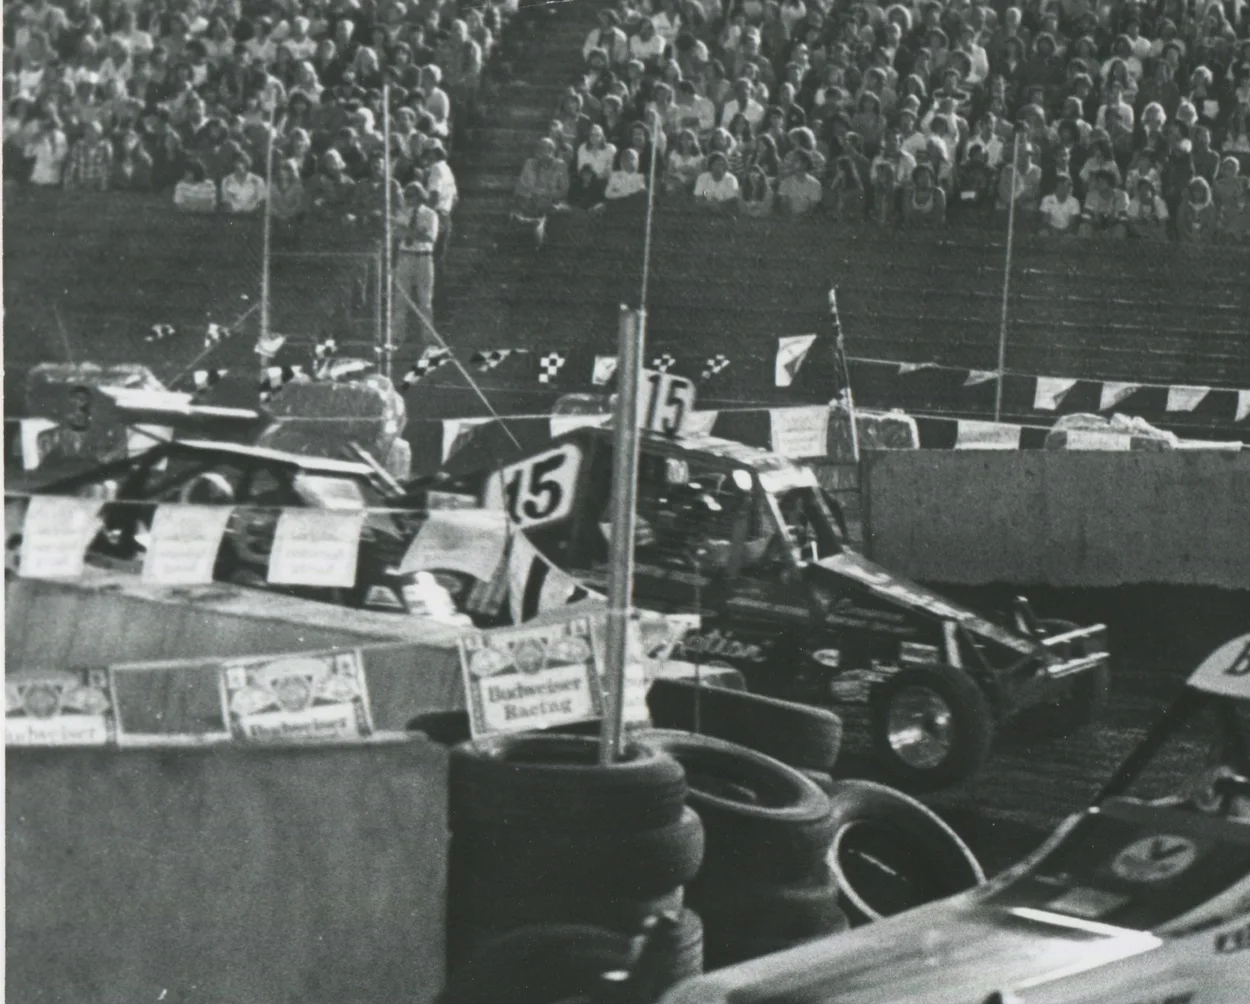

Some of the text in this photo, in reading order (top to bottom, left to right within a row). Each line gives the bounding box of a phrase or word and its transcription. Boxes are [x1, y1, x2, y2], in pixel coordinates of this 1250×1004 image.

[69, 386, 91, 431] 3
[646, 372, 688, 438] 15
[505, 453, 567, 525] 15
[487, 677, 582, 703] Budweiser
[503, 698, 573, 722] Racing
